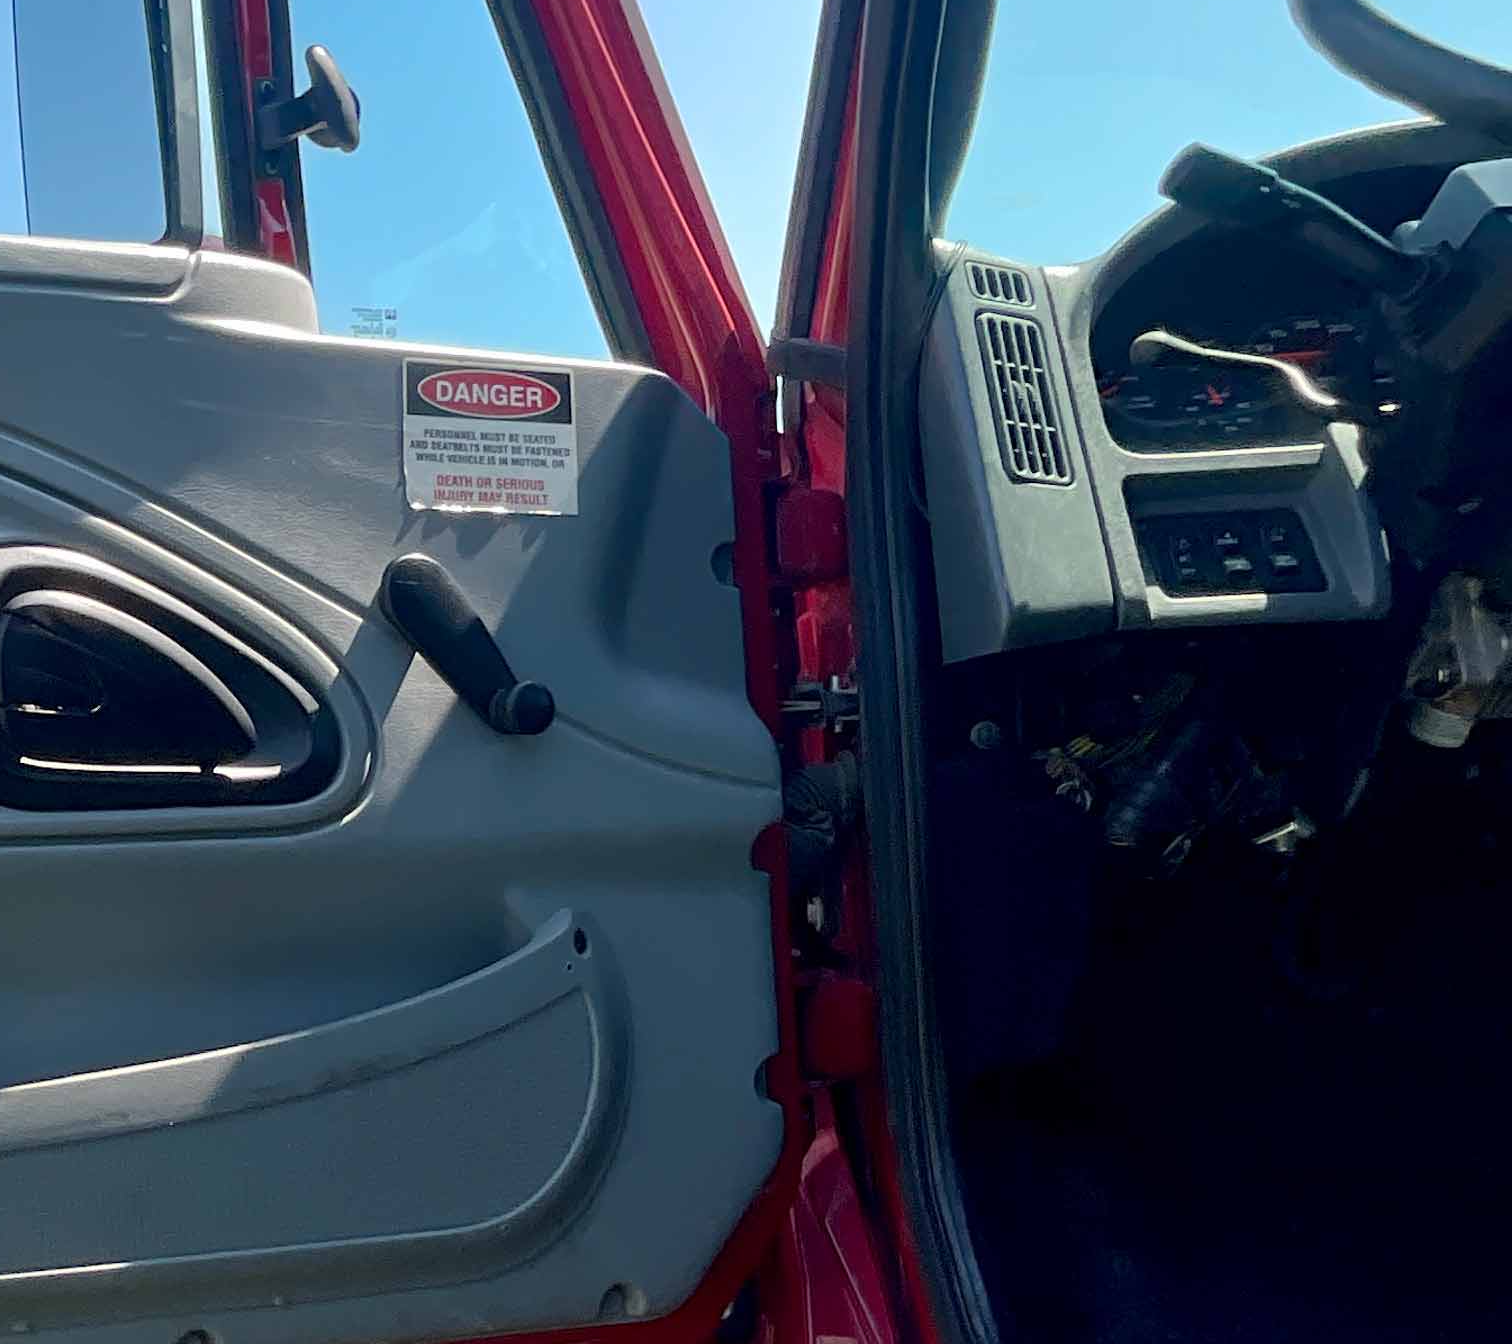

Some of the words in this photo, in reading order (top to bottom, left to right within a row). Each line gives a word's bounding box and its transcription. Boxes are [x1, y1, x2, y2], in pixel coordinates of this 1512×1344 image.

[436, 381, 543, 408] DANGER
[437, 475, 473, 487] DEATH
[496, 479, 544, 491] SERIOUS
[434, 489, 474, 502] INJURY
[505, 494, 548, 505] RESULT
